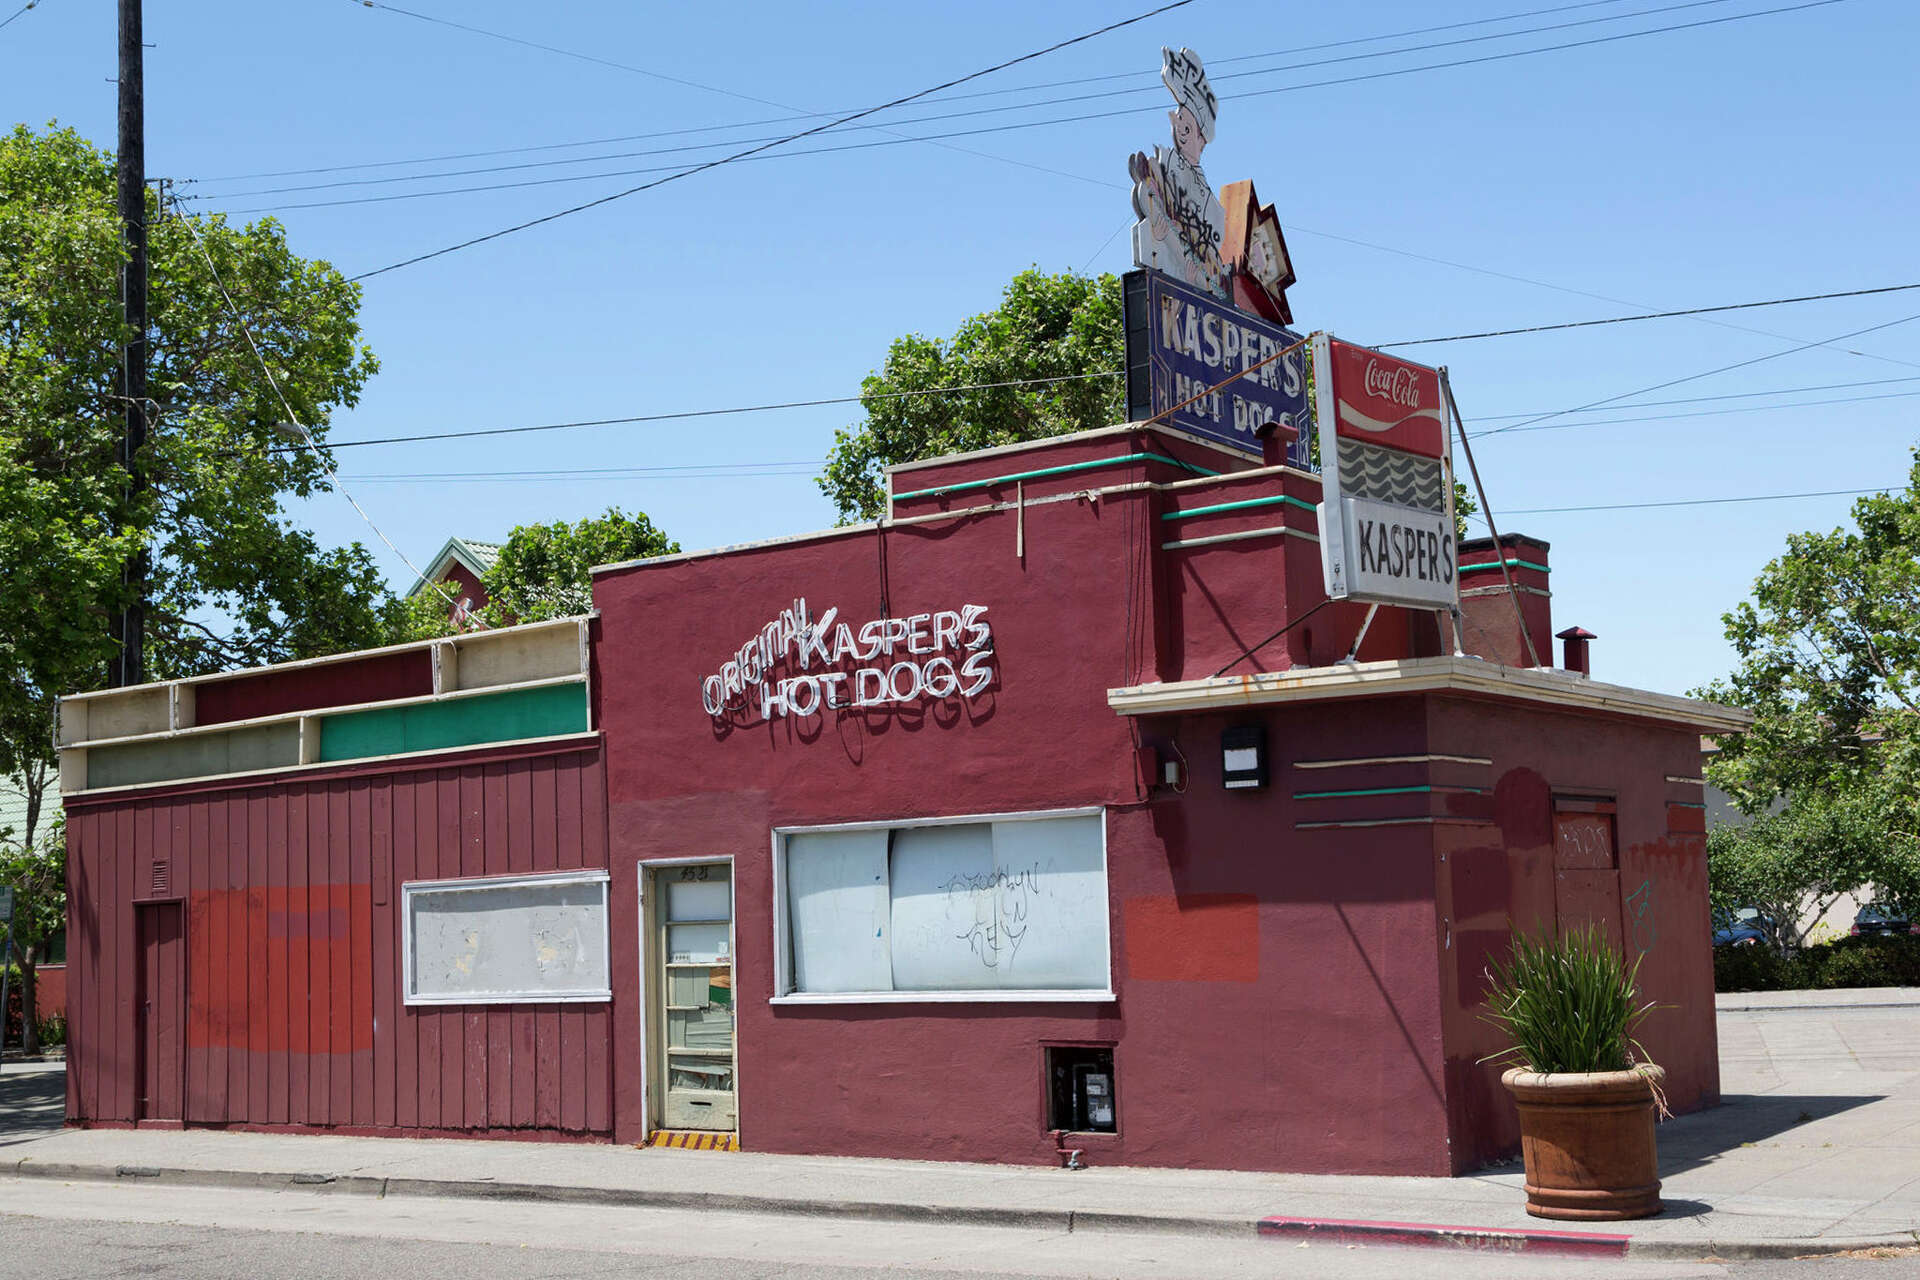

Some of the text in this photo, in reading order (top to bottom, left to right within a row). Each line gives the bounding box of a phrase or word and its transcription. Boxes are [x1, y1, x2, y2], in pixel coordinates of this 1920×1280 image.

[1161, 293, 1302, 398] KASPER'S
[1175, 372, 1226, 424] HOT
[1364, 358, 1420, 409] Coca-Cola
[1358, 520, 1454, 585] KASPER'S
[702, 598, 812, 716] ORIGINAL
[760, 650, 994, 720] HOT DOGS
